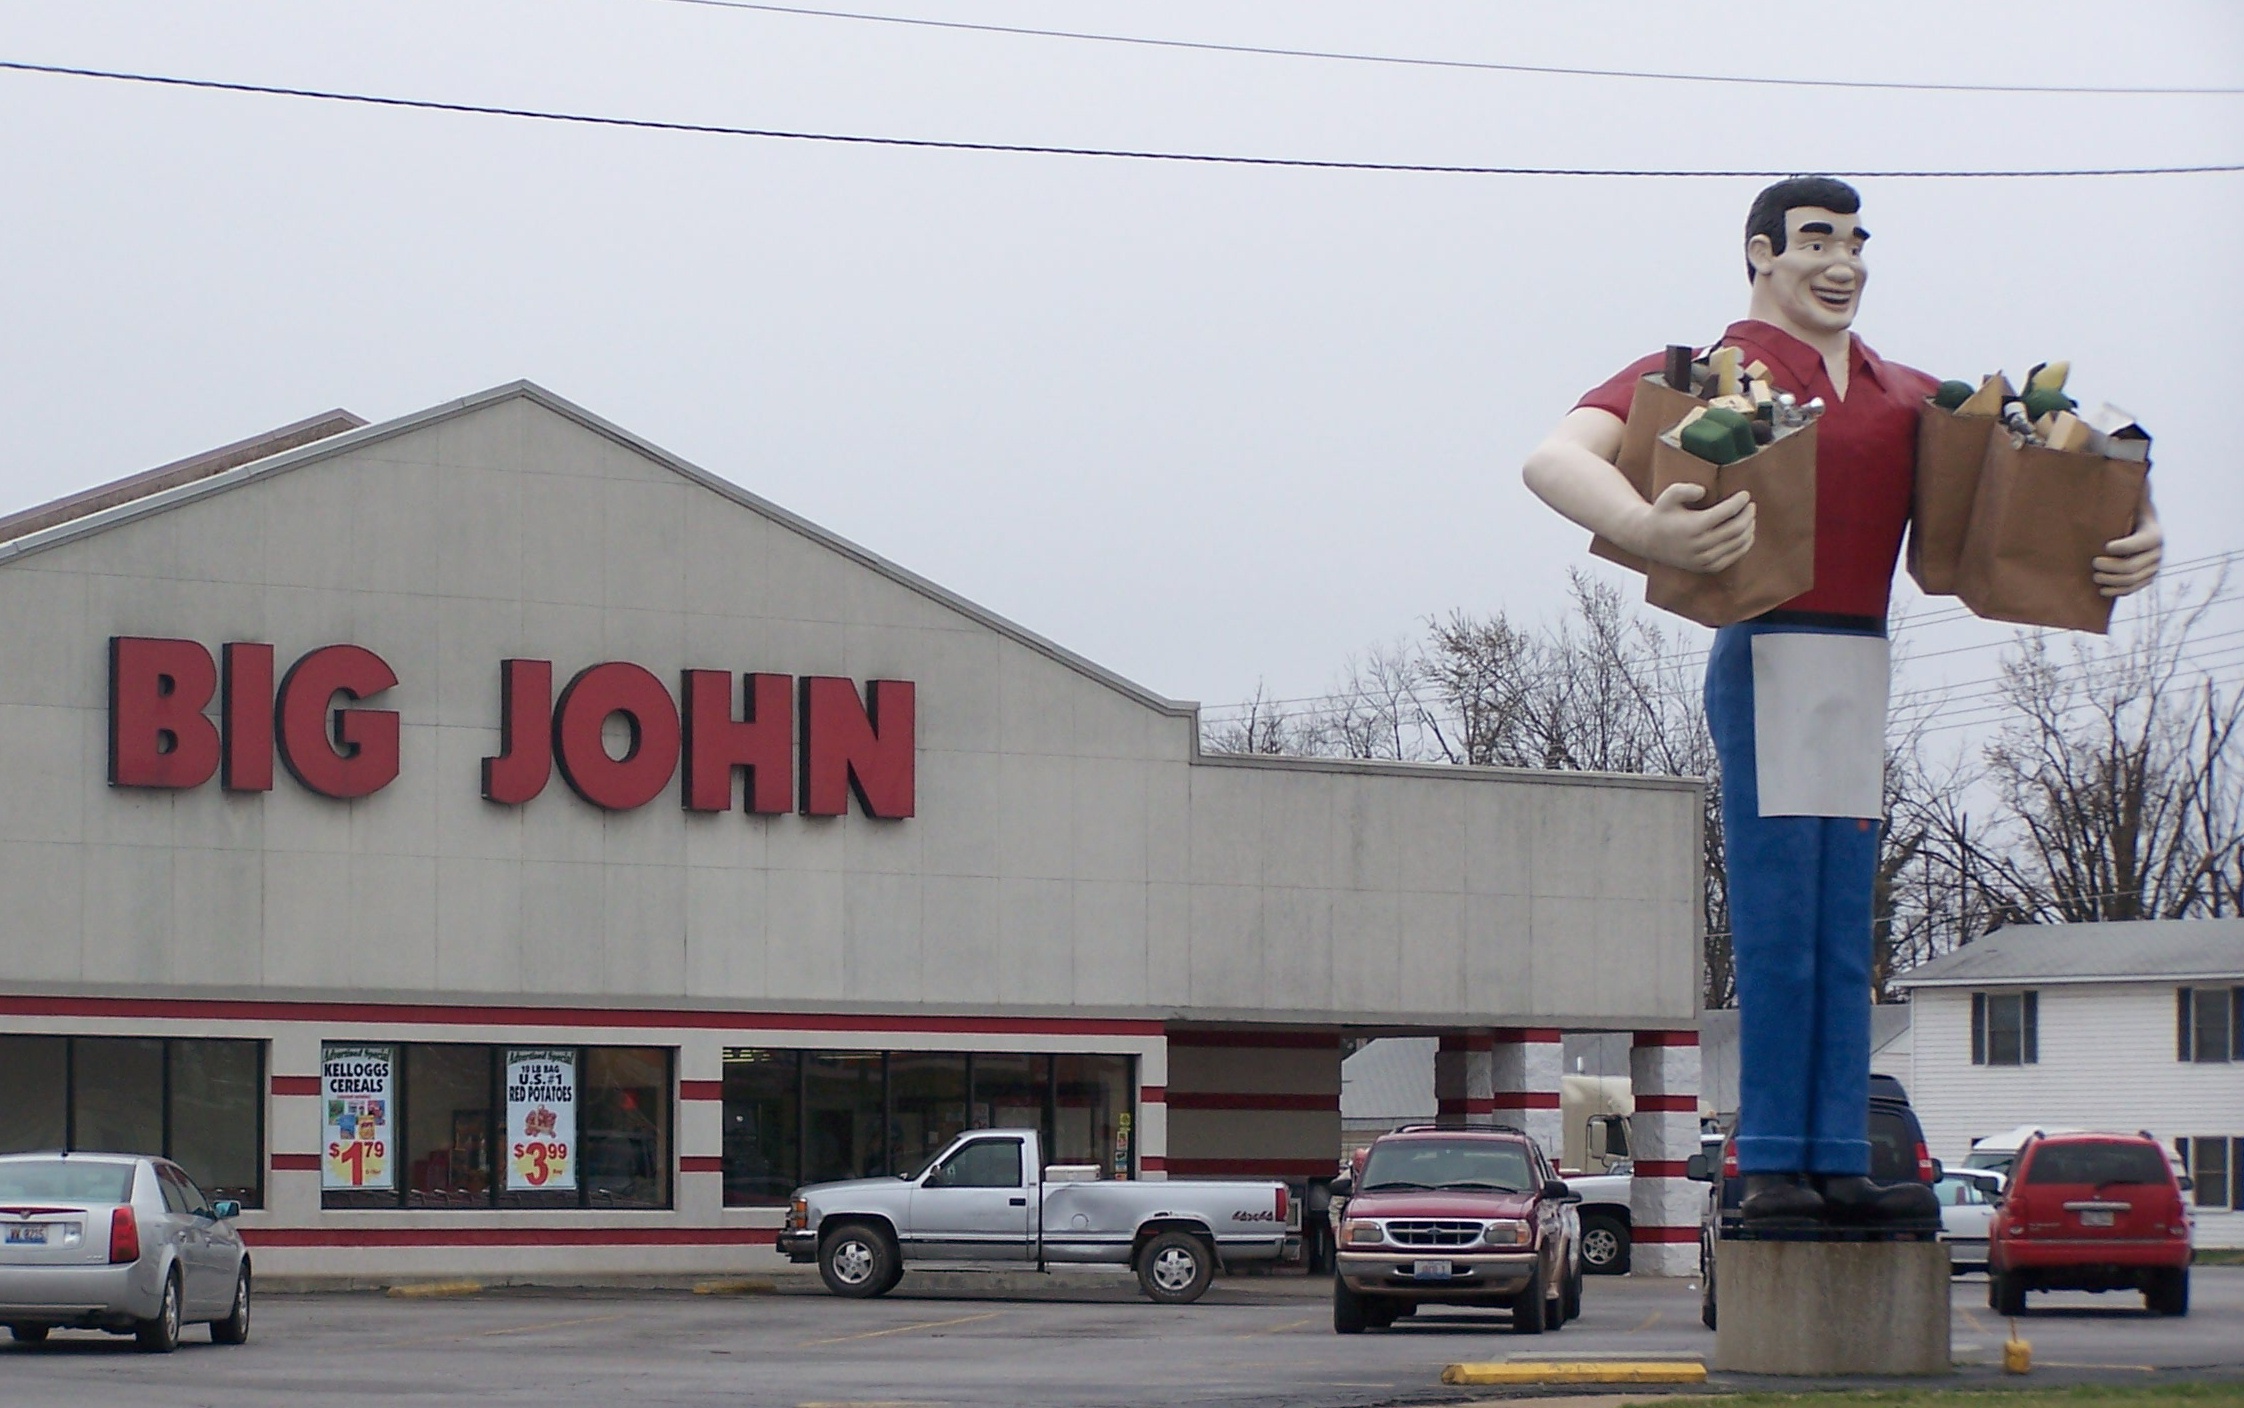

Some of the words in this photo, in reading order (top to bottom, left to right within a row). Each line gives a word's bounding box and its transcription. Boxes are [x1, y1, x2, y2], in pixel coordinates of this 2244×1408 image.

[108, 636, 400, 798] BIG
[481, 658, 916, 820] JOHN
[324, 1063, 389, 1078] KELLOGGS
[532, 1065, 541, 1074] LB
[544, 1065, 560, 1074] BAG
[330, 1078, 384, 1093] CEREALS
[519, 1073, 546, 1085] U.S.
[509, 1086, 526, 1103] RED
[528, 1086, 572, 1103] POTATOES
